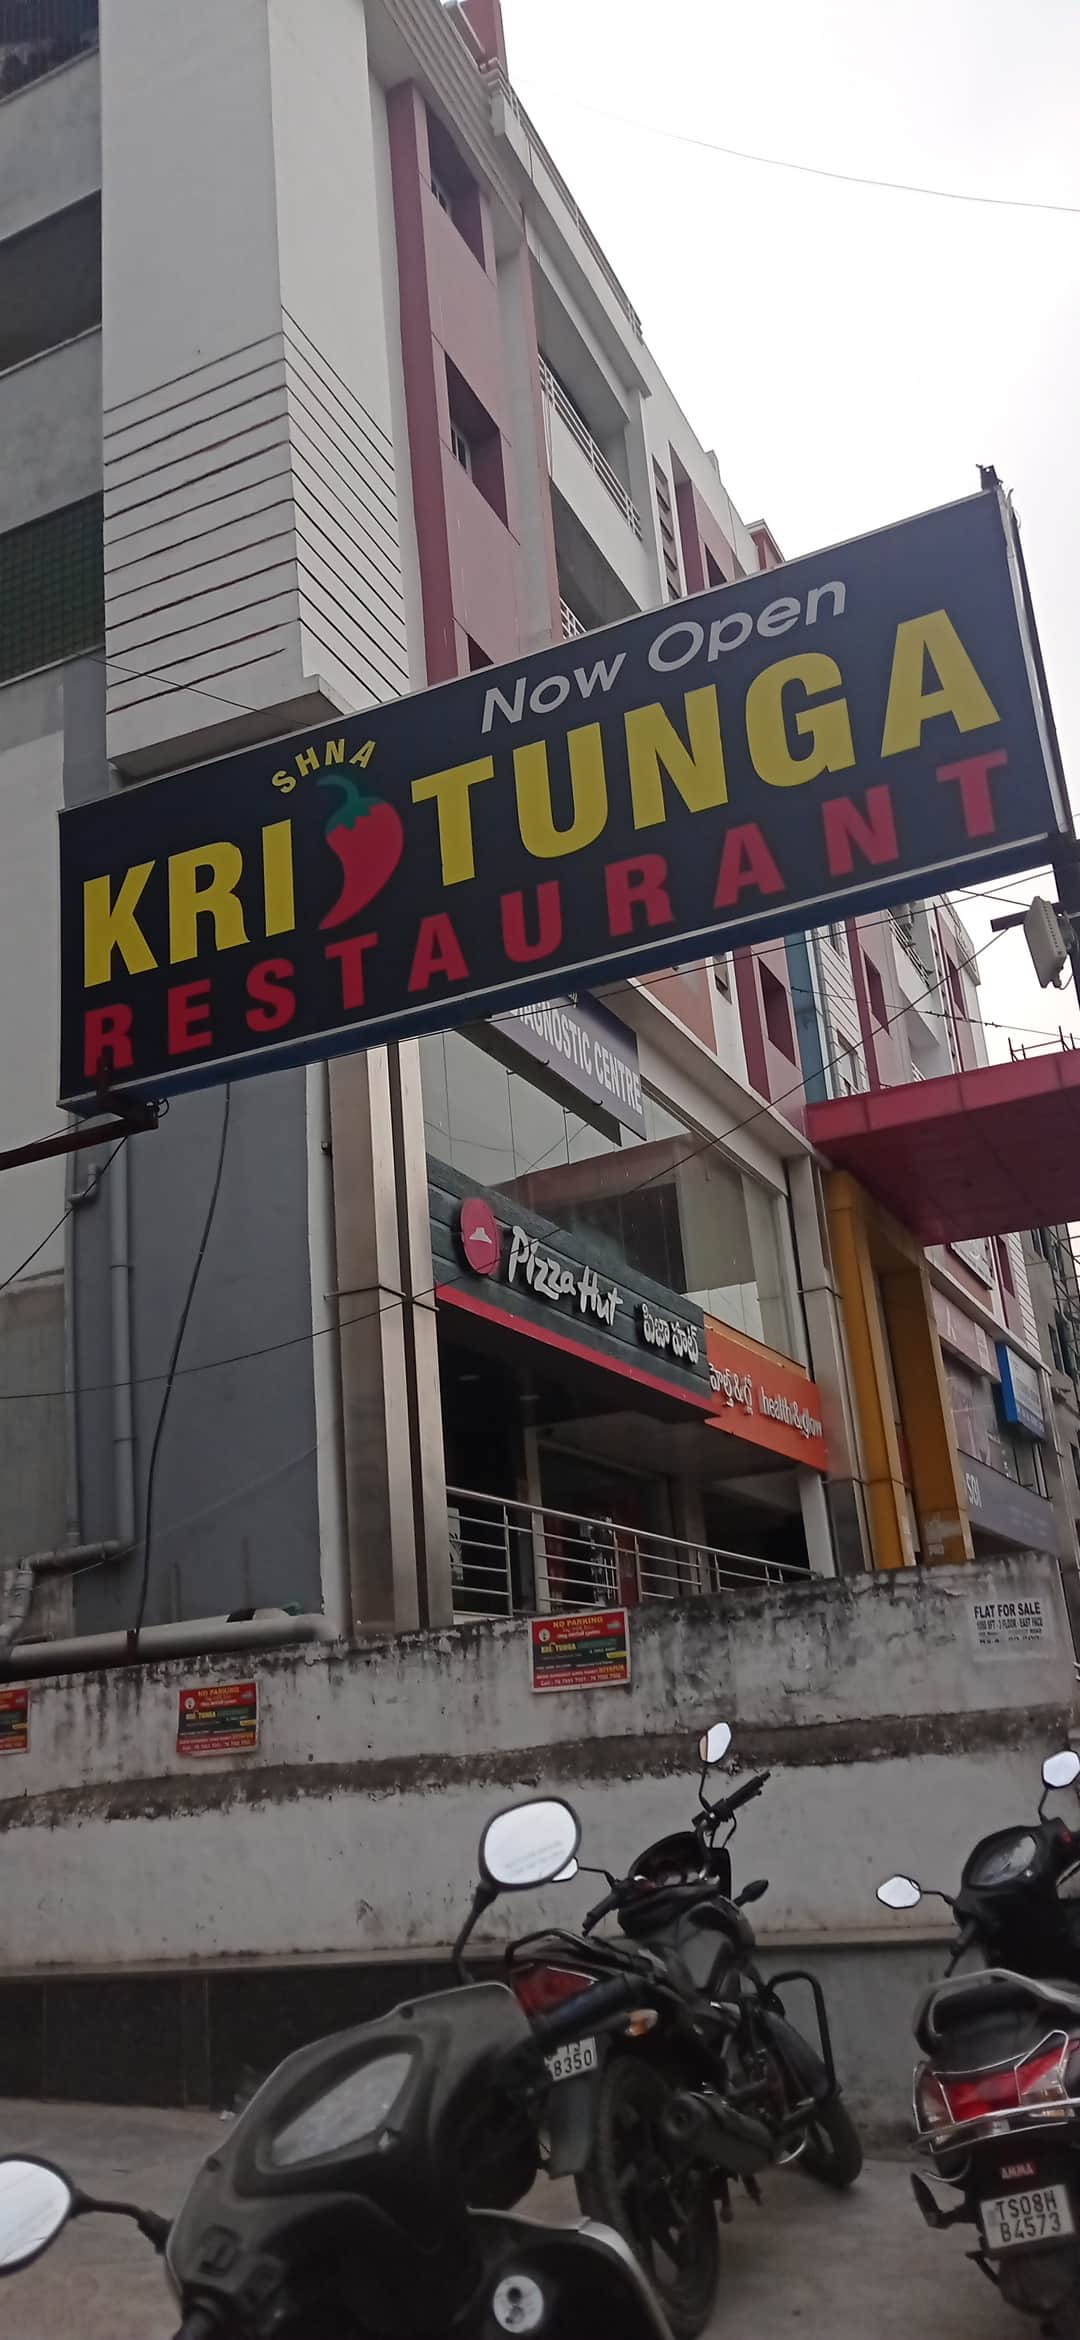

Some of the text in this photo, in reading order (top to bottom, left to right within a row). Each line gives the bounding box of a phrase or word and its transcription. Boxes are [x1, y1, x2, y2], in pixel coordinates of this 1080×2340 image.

[481, 580, 847, 734] Now Open
[83, 608, 1001, 988] KRI TUNGA
[271, 738, 377, 794] SHNA
[83, 748, 1008, 1078] RESTAURANT
[593, 1041, 643, 1115] CENTRE
[508, 1225, 624, 1327] Pizza Hut
[974, 1601, 1041, 1619] FLAT FOR SALE
[553, 2048, 592, 2078] 8350
[995, 2189, 1057, 2221] TS08H
[1000, 2210, 1061, 2243] B4573
